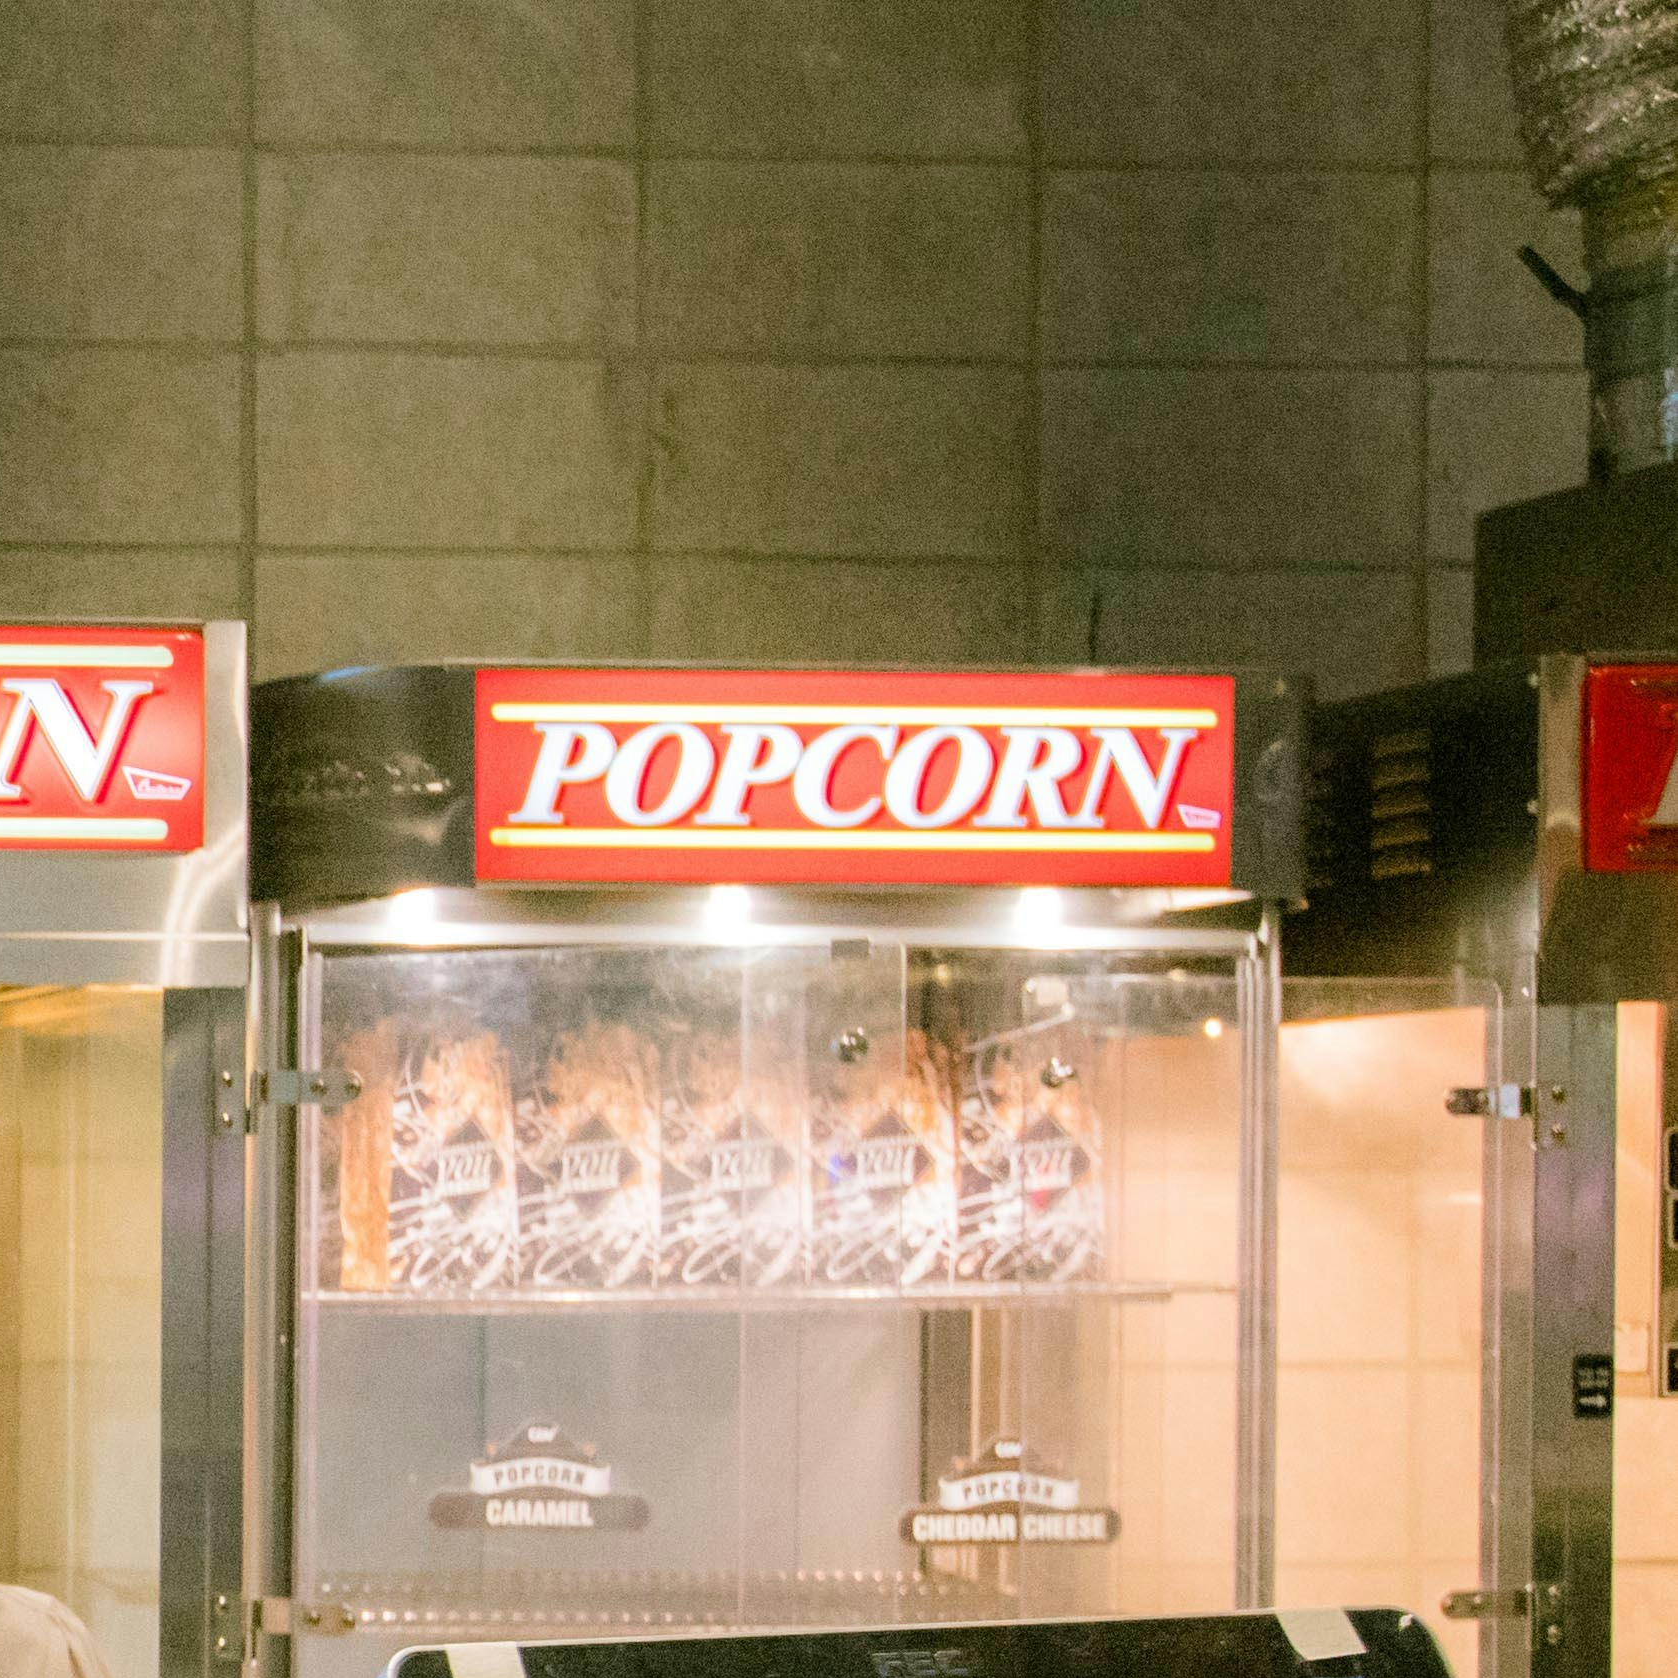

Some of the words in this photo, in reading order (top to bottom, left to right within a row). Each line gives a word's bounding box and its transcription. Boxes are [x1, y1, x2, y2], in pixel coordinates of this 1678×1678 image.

[508, 721, 1198, 829] POPCORN
[494, 1465, 585, 1487] POPCORN
[962, 1480, 1054, 1502] POPCORN
[486, 1499, 593, 1526] CARAMEL
[913, 1513, 1017, 1542] CHEDDAR
[1023, 1514, 1107, 1541] CHEESE
